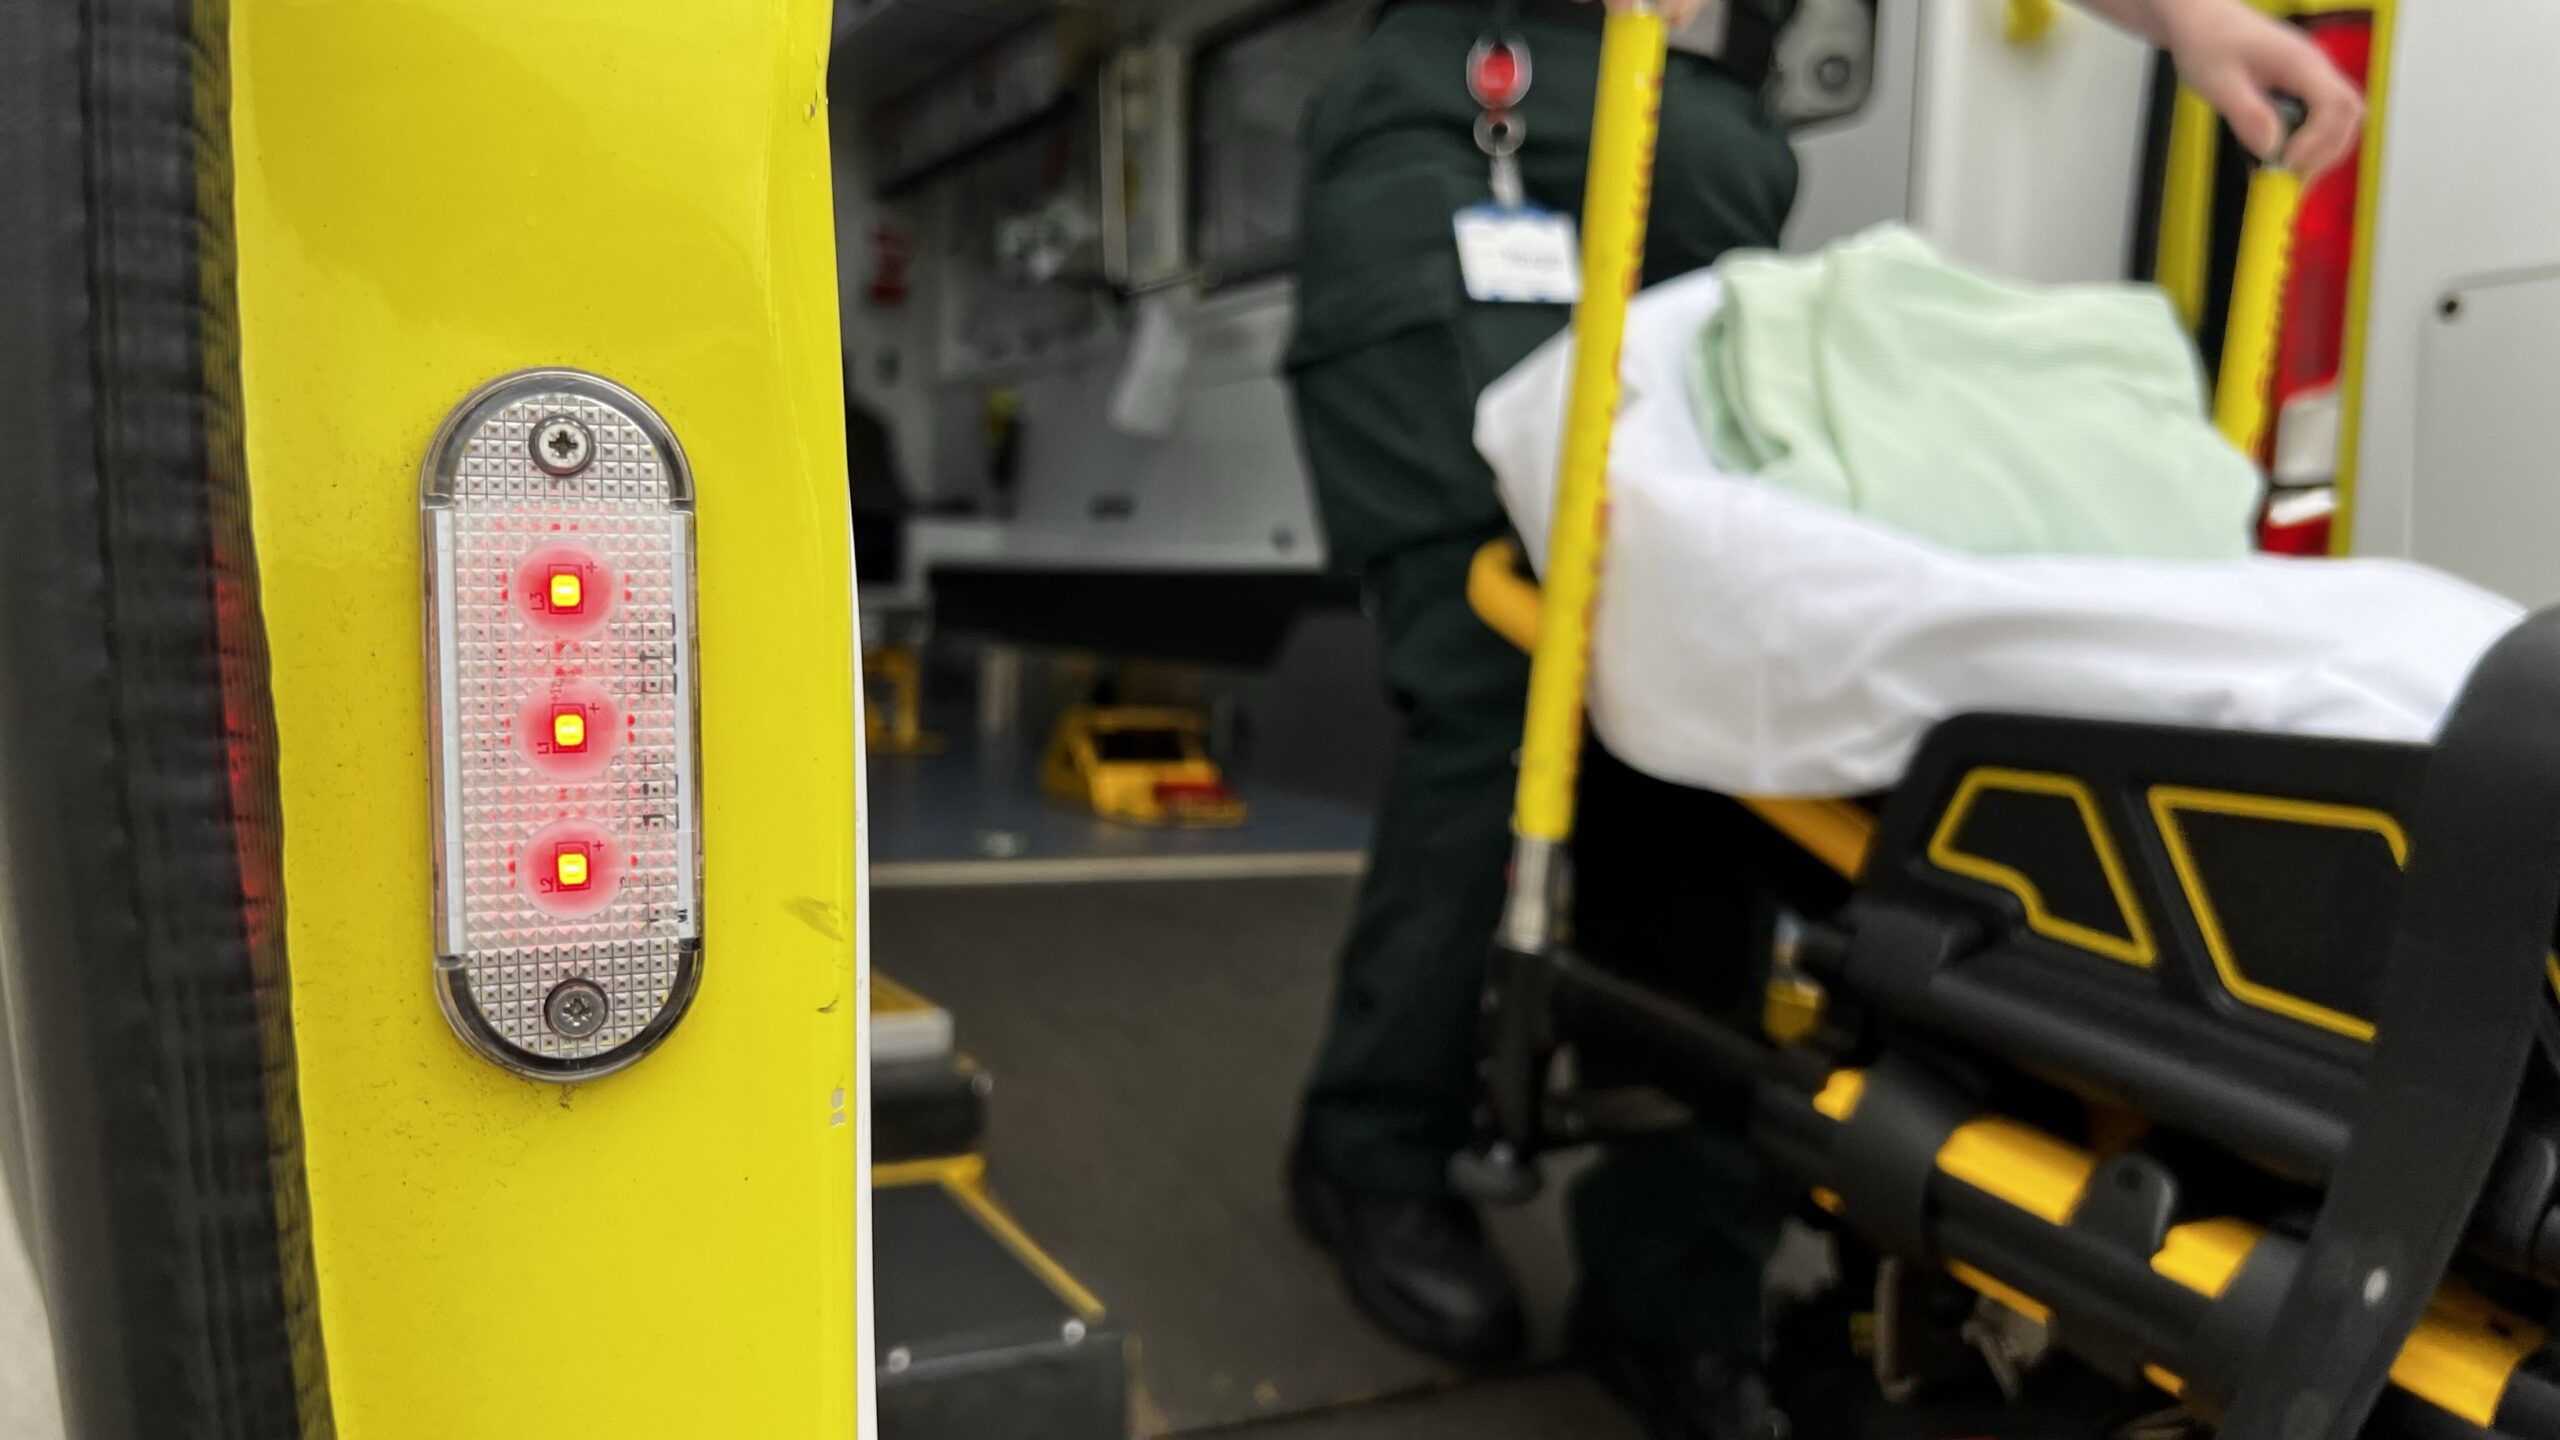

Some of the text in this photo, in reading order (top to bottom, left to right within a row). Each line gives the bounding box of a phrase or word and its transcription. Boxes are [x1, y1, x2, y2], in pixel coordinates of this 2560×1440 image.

[529, 592, 546, 611] L3
[536, 742, 550, 754] L1
[540, 877, 554, 894] L2
